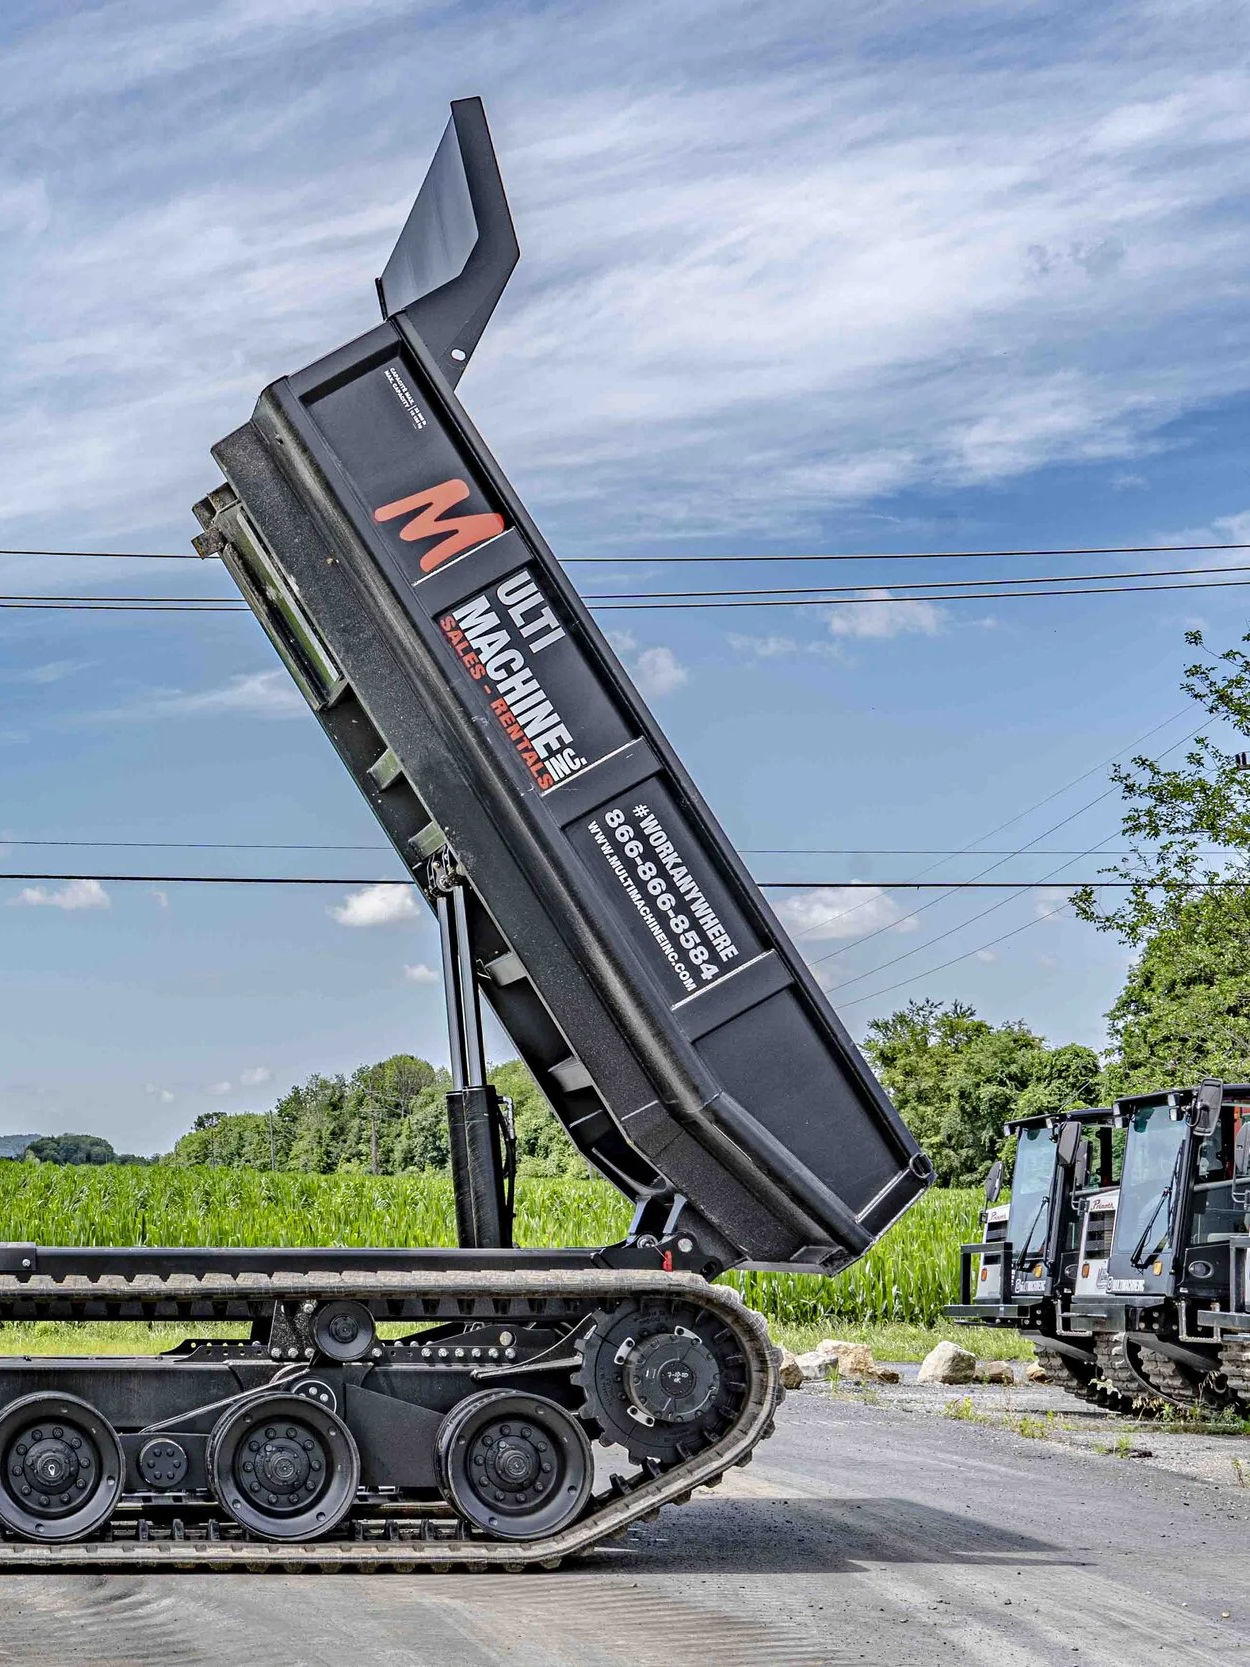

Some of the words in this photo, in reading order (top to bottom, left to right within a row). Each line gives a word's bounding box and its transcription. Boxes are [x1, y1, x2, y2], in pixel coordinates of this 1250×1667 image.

[392, 383, 411, 408] CAPACITY
[439, 615, 487, 680] SALES
[489, 697, 555, 790] RENTALS
[452, 594, 574, 760] MACHINE
[544, 748, 588, 782] INC.
[587, 820, 697, 992] WWW.MULTIMACHINEINC.COM
[604, 808, 719, 981] 866-866-8584
[632, 804, 739, 962] #WORKANYWHERE
